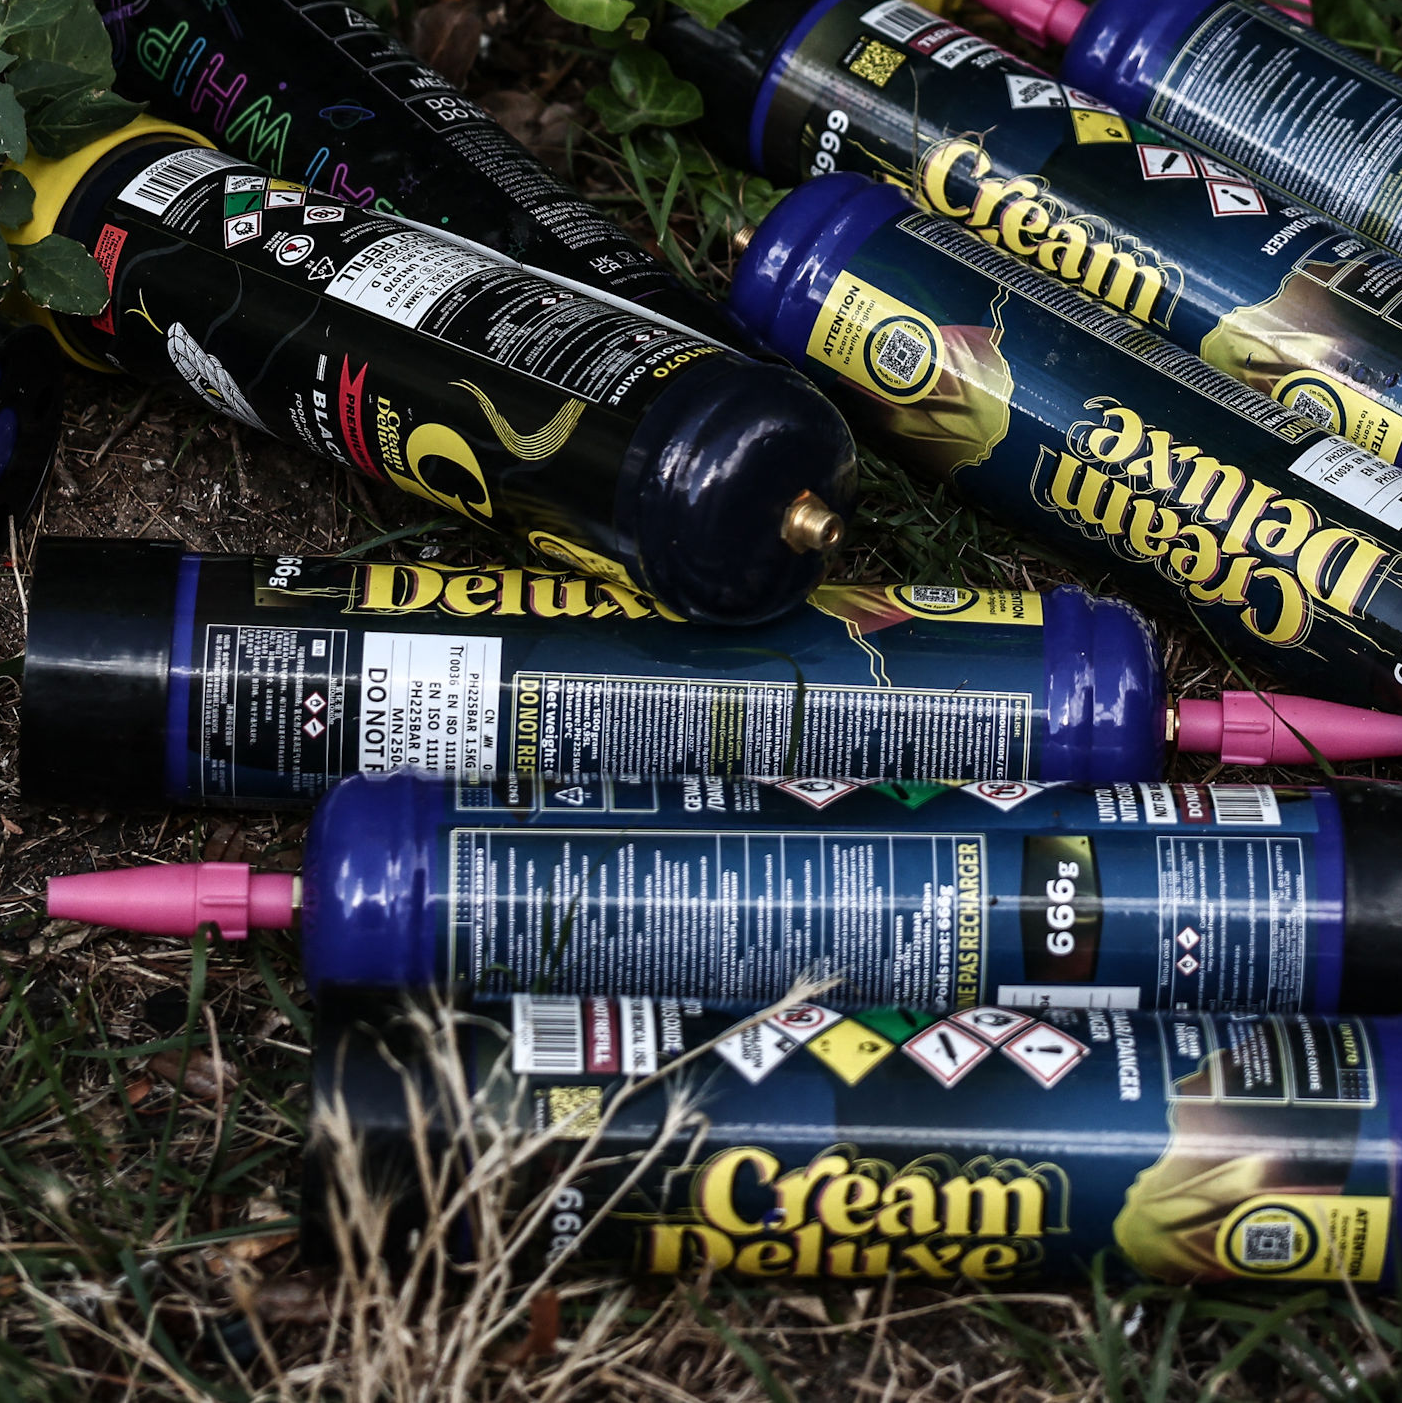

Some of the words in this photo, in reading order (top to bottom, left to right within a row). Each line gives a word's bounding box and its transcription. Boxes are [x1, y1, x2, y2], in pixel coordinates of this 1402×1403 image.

[125, 13, 292, 176] WHIP
[918, 139, 1155, 325] Cream
[335, 240, 395, 283] REFILL
[380, 264, 397, 279] CN
[382, 262, 419, 294] UN1070
[384, 273, 420, 309] 2025/02
[823, 284, 861, 357] ATTENTION
[855, 298, 876, 332] Original
[836, 334, 849, 356] Scan
[844, 321, 854, 334] QR
[846, 332, 860, 357] verify
[842, 355, 851, 365] to
[605, 363, 647, 407] OXIDE
[374, 395, 394, 466] Deluxe
[386, 410, 406, 471] Cream
[1368, 417, 1390, 456] ATTEN
[1082, 406, 1390, 616] Deluxe
[1048, 451, 1305, 640] Cream
[357, 563, 688, 620] Delux
[366, 667, 388, 703] DO
[428, 681, 441, 699] EN
[446, 693, 458, 709] EN
[465, 672, 479, 731] PH225BAR
[518, 678, 535, 703] DO
[407, 679, 423, 749] PH225BAR
[426, 707, 440, 730] ISO
[444, 714, 457, 735] ISO
[483, 709, 495, 724] CN
[517, 707, 534, 742] NOT
[997, 700, 1006, 736] NITROUS
[364, 709, 385, 758] NOT
[996, 736, 1005, 761] OXIDE
[464, 737, 478, 768] 1.5KG
[957, 842, 980, 951] RECHARGER
[1044, 863, 1079, 957] 666g
[702, 1146, 1043, 1239] Cream
